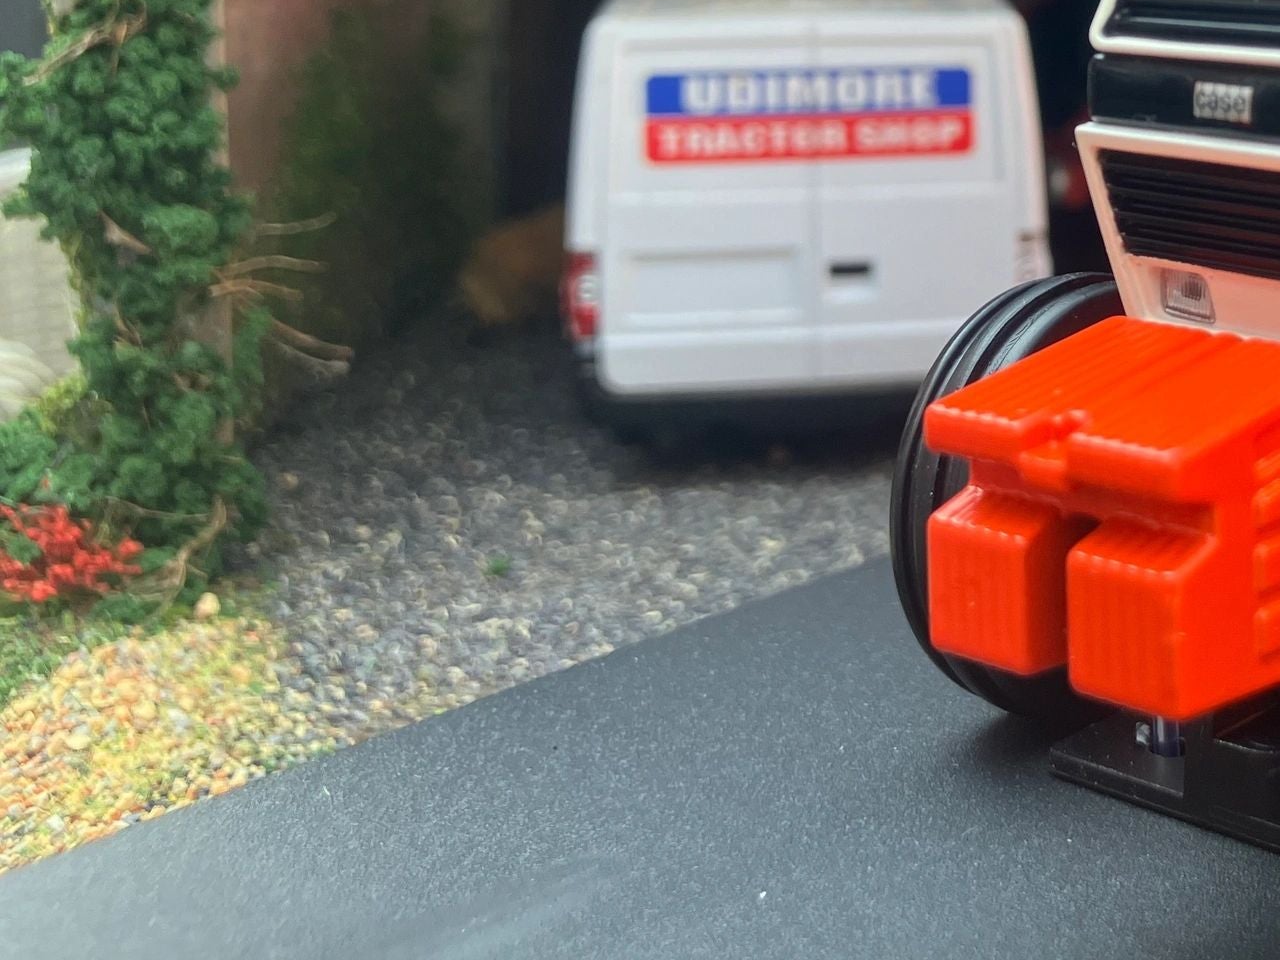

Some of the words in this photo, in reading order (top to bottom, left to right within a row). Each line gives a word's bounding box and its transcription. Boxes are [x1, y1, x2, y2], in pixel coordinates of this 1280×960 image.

[685, 70, 935, 114] UDIMORE
[659, 118, 847, 159] TRACTOR
[855, 114, 964, 151] SHOP
